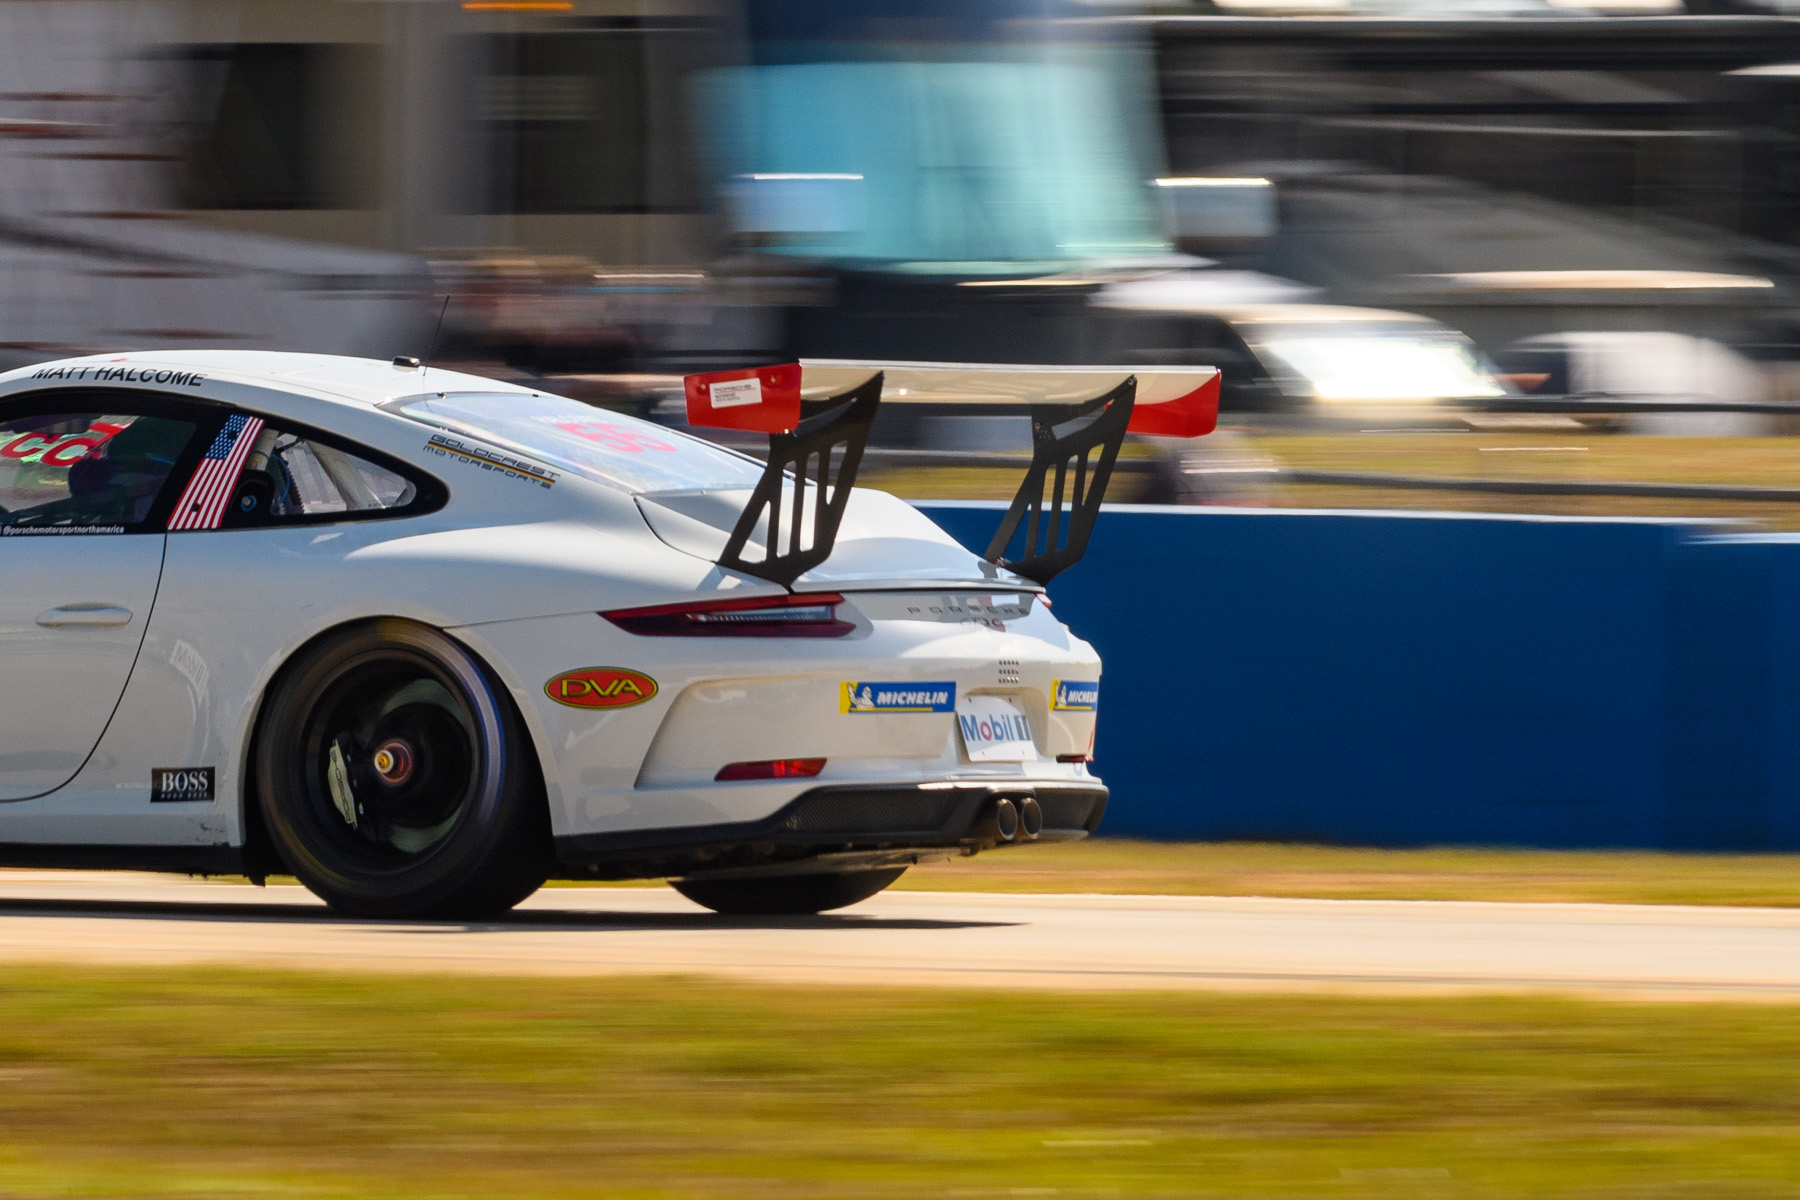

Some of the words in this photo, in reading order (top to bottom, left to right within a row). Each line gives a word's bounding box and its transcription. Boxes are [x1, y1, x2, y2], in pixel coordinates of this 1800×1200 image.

[31, 366, 94, 380] MATT
[94, 366, 208, 387] HALCOME
[555, 422, 678, 453] 55
[422, 444, 553, 490] MOTORSPORTS
[430, 433, 561, 478] GOLDCREST
[906, 605, 1030, 616] PORSCHE
[560, 678, 644, 697] DVA
[876, 690, 949, 706] MICHELIN
[960, 714, 1014, 742] Mobil
[161, 770, 209, 793] BOSS
